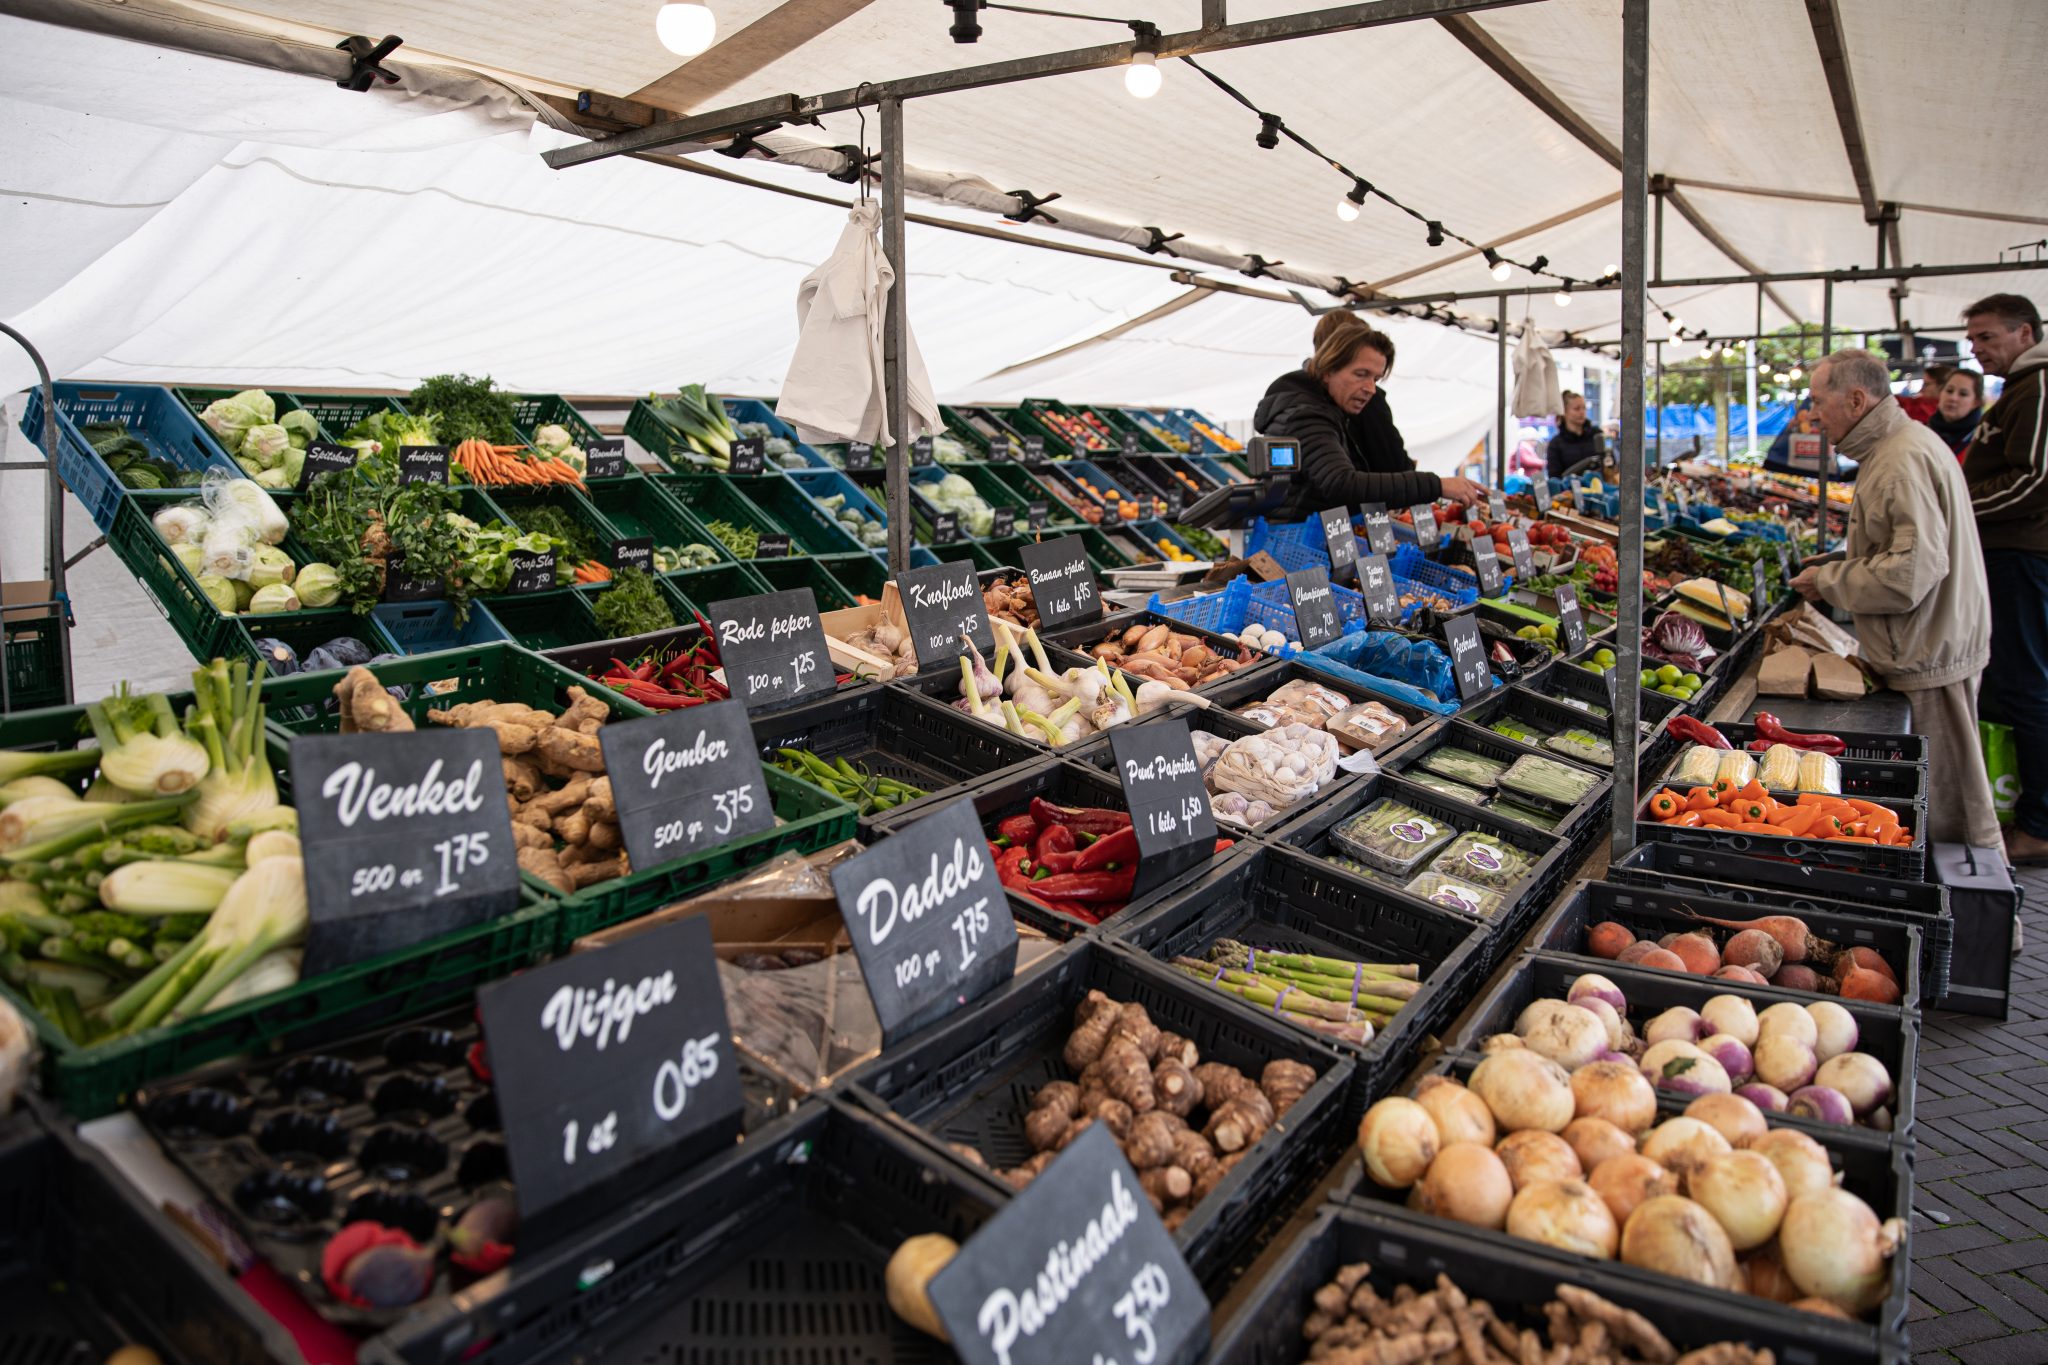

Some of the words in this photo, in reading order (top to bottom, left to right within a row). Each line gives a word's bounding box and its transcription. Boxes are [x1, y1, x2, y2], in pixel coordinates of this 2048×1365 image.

[309, 447, 354, 464] Spitskool
[618, 546, 649, 560] Bospeen
[1030, 568, 1063, 585] Banaan
[1064, 559, 1086, 580] sjalot
[910, 574, 974, 611] Knoflook
[1049, 600, 1055, 615] 1
[1056, 598, 1071, 613] kilo
[1074, 581, 1091, 610] 495
[719, 617, 766, 647] Rode
[770, 614, 813, 643] peper
[929, 634, 944, 649] 100
[748, 673, 769, 695] 100
[790, 650, 816, 693] 125
[643, 729, 729, 790] Gember
[1126, 759, 1155, 785] Punt
[1155, 752, 1197, 782] Paprika
[322, 758, 484, 827] Venkel
[654, 820, 684, 849] 500
[687, 820, 704, 843] gr
[712, 784, 754, 835] 375
[1149, 812, 1156, 836] 1
[1158, 810, 1177, 833] kilo
[1181, 796, 1202, 836] 450
[351, 863, 396, 896] 500
[433, 831, 490, 896] 175
[856, 837, 985, 946] Dadels
[895, 953, 922, 988] 100
[925, 949, 942, 977] gr
[952, 897, 990, 971] 175
[541, 970, 678, 1051] Vijgen
[563, 1119, 579, 1165] 1
[653, 1032, 721, 1121] 085
[977, 1169, 1139, 1365] Pastinaak
